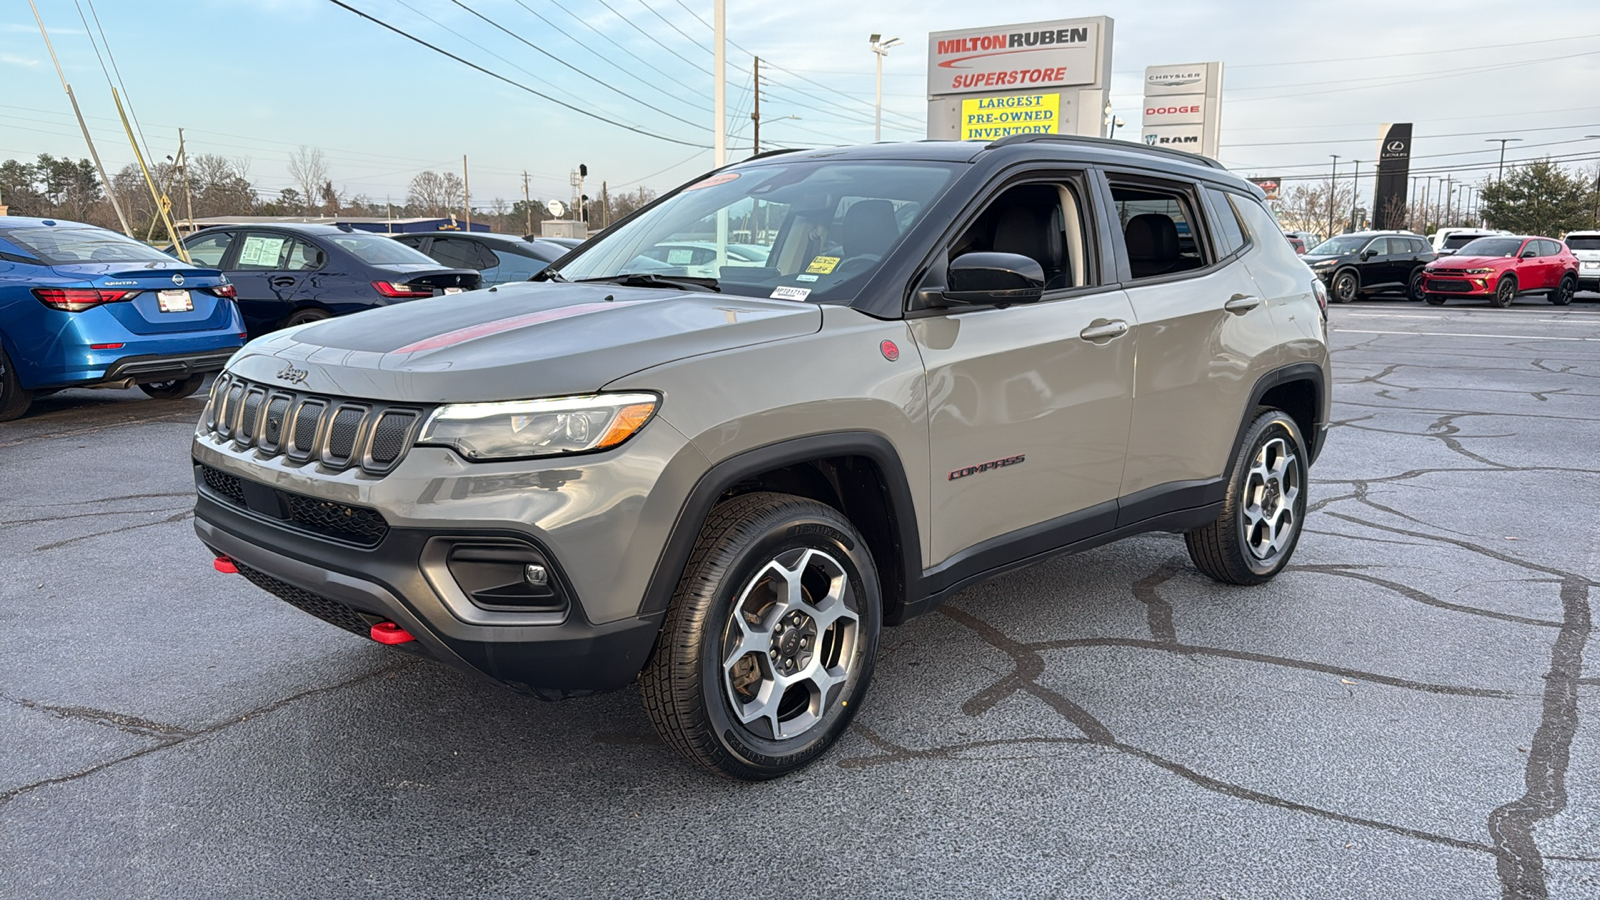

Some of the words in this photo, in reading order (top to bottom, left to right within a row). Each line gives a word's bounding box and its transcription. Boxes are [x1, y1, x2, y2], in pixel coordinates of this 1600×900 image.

[937, 34, 1007, 55] MILTON
[1008, 27, 1088, 48] RUBEN
[952, 67, 1067, 89] SUPERSTORE
[978, 95, 1043, 109] LARGEST
[967, 110, 1053, 124] PRE-OWNED
[1146, 106, 1200, 115] DODGE
[968, 124, 1052, 138] INVENTORY
[1160, 136, 1198, 144] RAM
[276, 363, 309, 385] Jeep
[947, 453, 1026, 481] COMPASS
